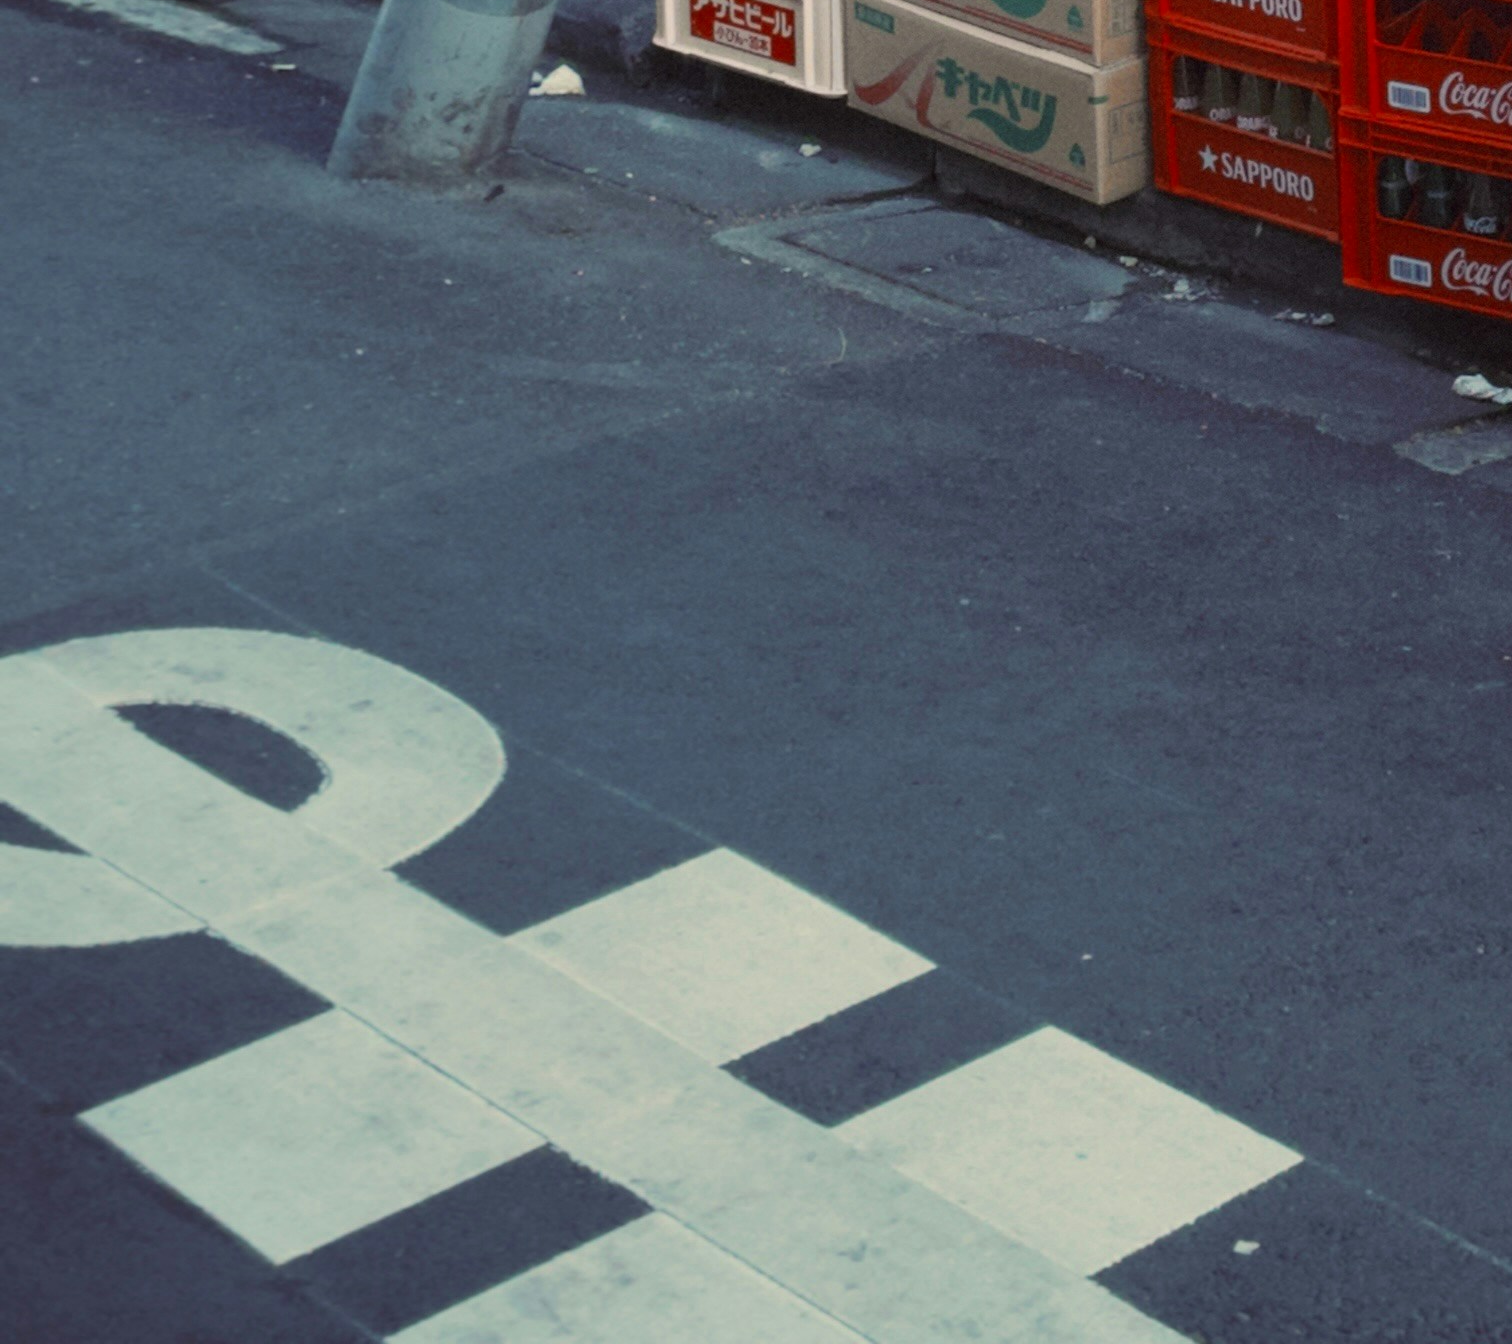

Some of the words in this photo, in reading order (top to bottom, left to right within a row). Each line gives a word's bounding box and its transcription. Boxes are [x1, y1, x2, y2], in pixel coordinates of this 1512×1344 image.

[935, 57, 1057, 153] キャベツ
[1220, 152, 1314, 201] SAPPORO
